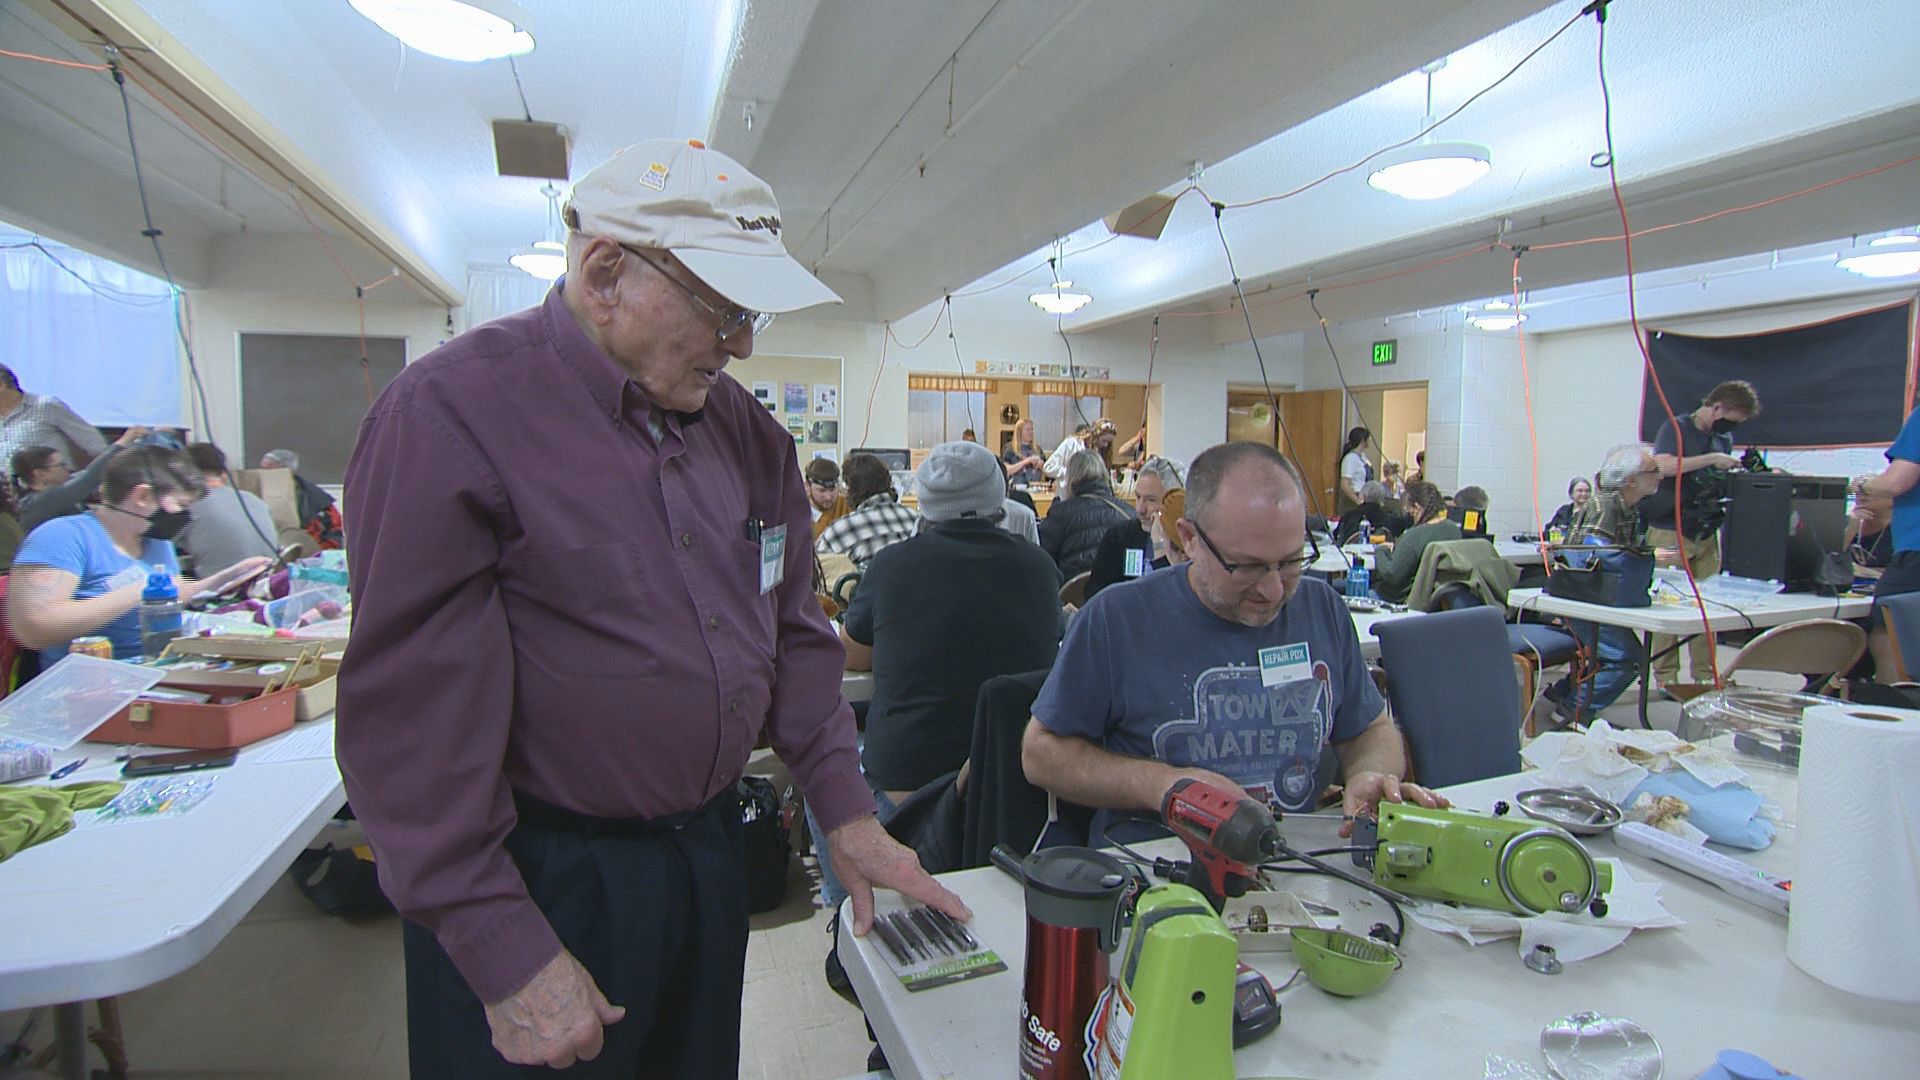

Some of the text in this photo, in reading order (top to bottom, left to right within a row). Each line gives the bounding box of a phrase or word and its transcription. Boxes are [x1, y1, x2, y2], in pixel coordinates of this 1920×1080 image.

[1374, 343, 1393, 363] EXIT
[1264, 648, 1305, 665] REPAIR PDX
[1208, 693, 1267, 721] TOW
[1187, 728, 1298, 762] MATER
[1028, 1015, 1061, 1052] Safe
